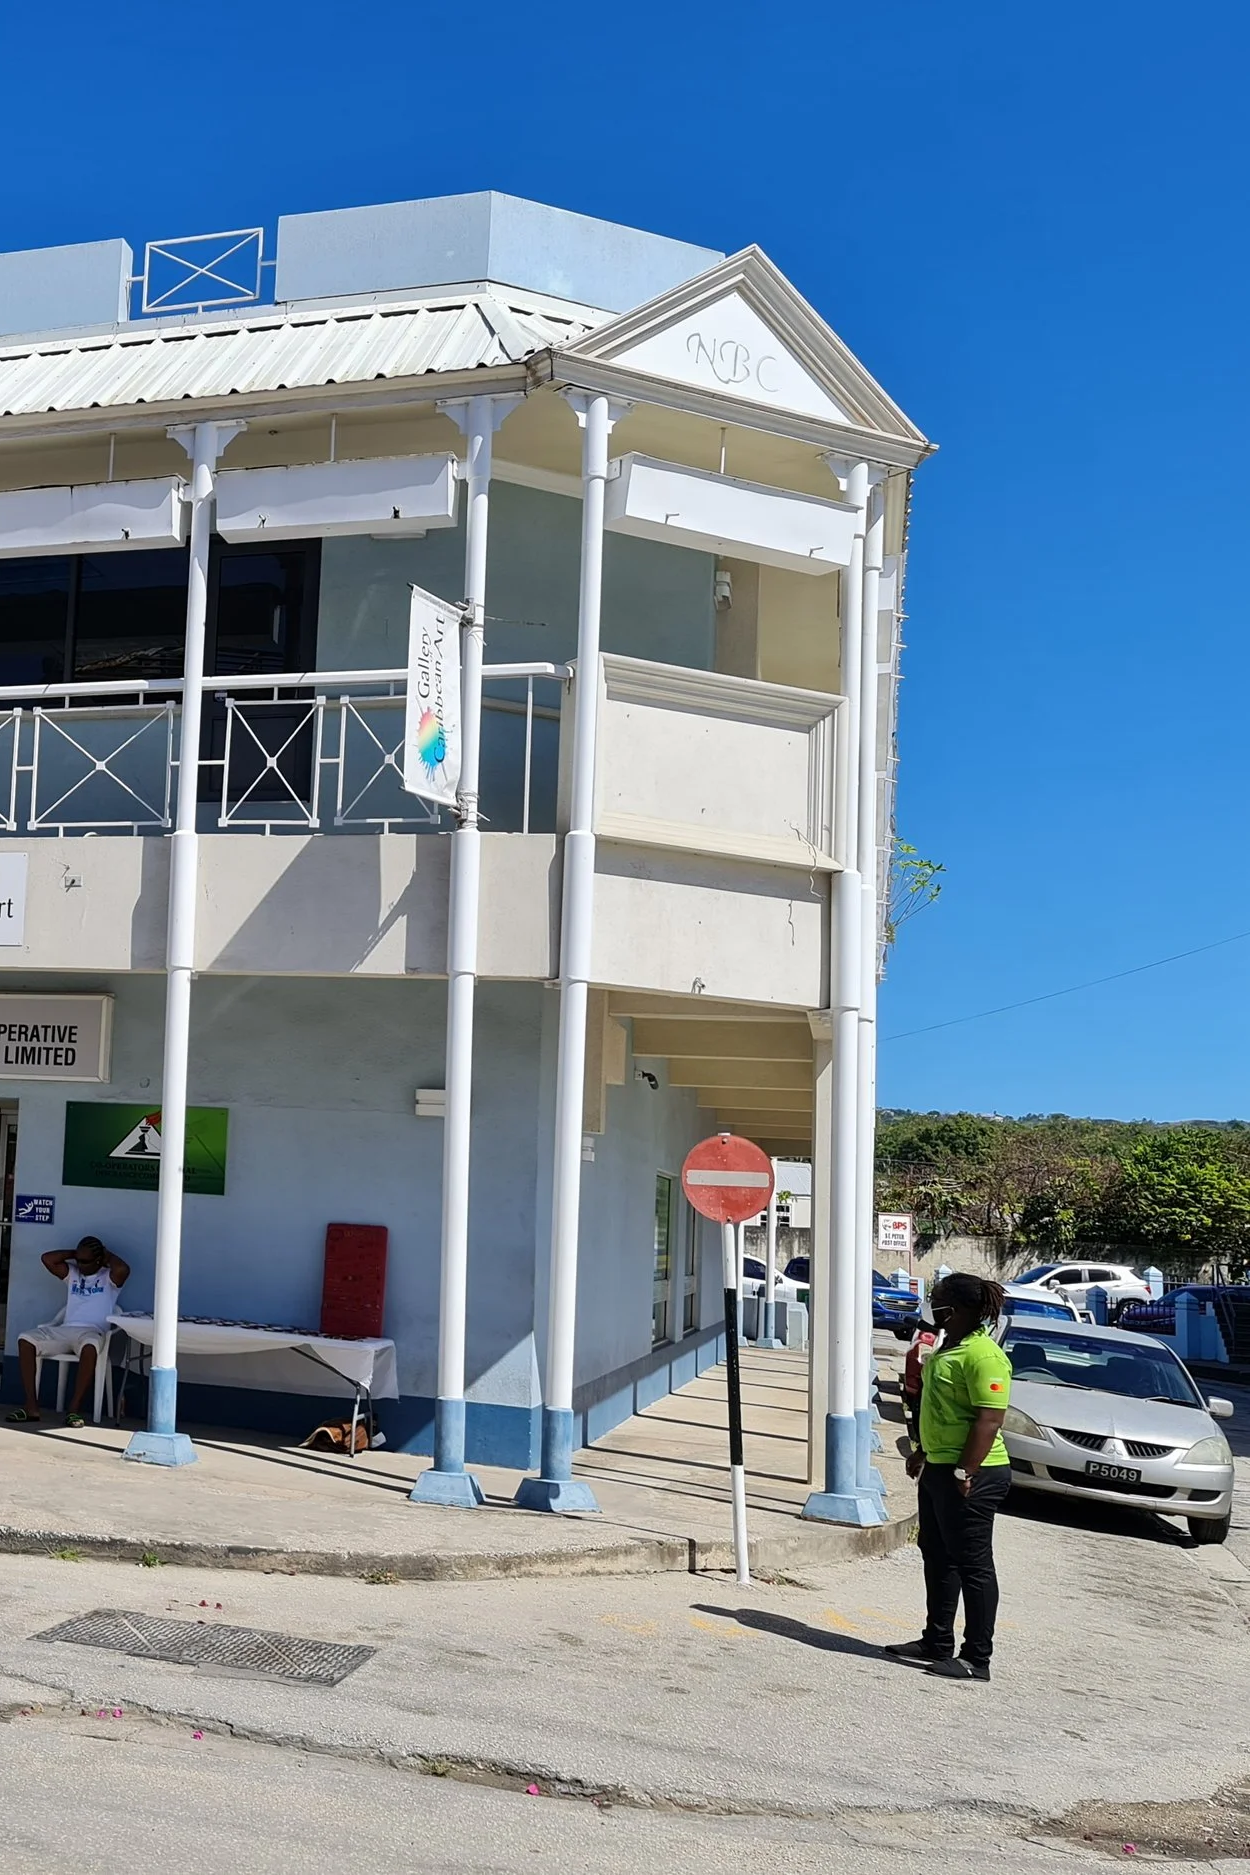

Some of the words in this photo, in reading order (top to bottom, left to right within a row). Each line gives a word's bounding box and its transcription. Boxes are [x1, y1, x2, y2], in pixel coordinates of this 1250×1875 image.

[687, 332, 782, 393] NBC
[433, 615, 445, 660] Art
[418, 626, 432, 699] Gallery
[433, 660, 447, 763] Caribbean
[4, 1046, 77, 1066] LIMITED
[892, 1221, 908, 1230] BPS
[1089, 1462, 1137, 1482] P5049
